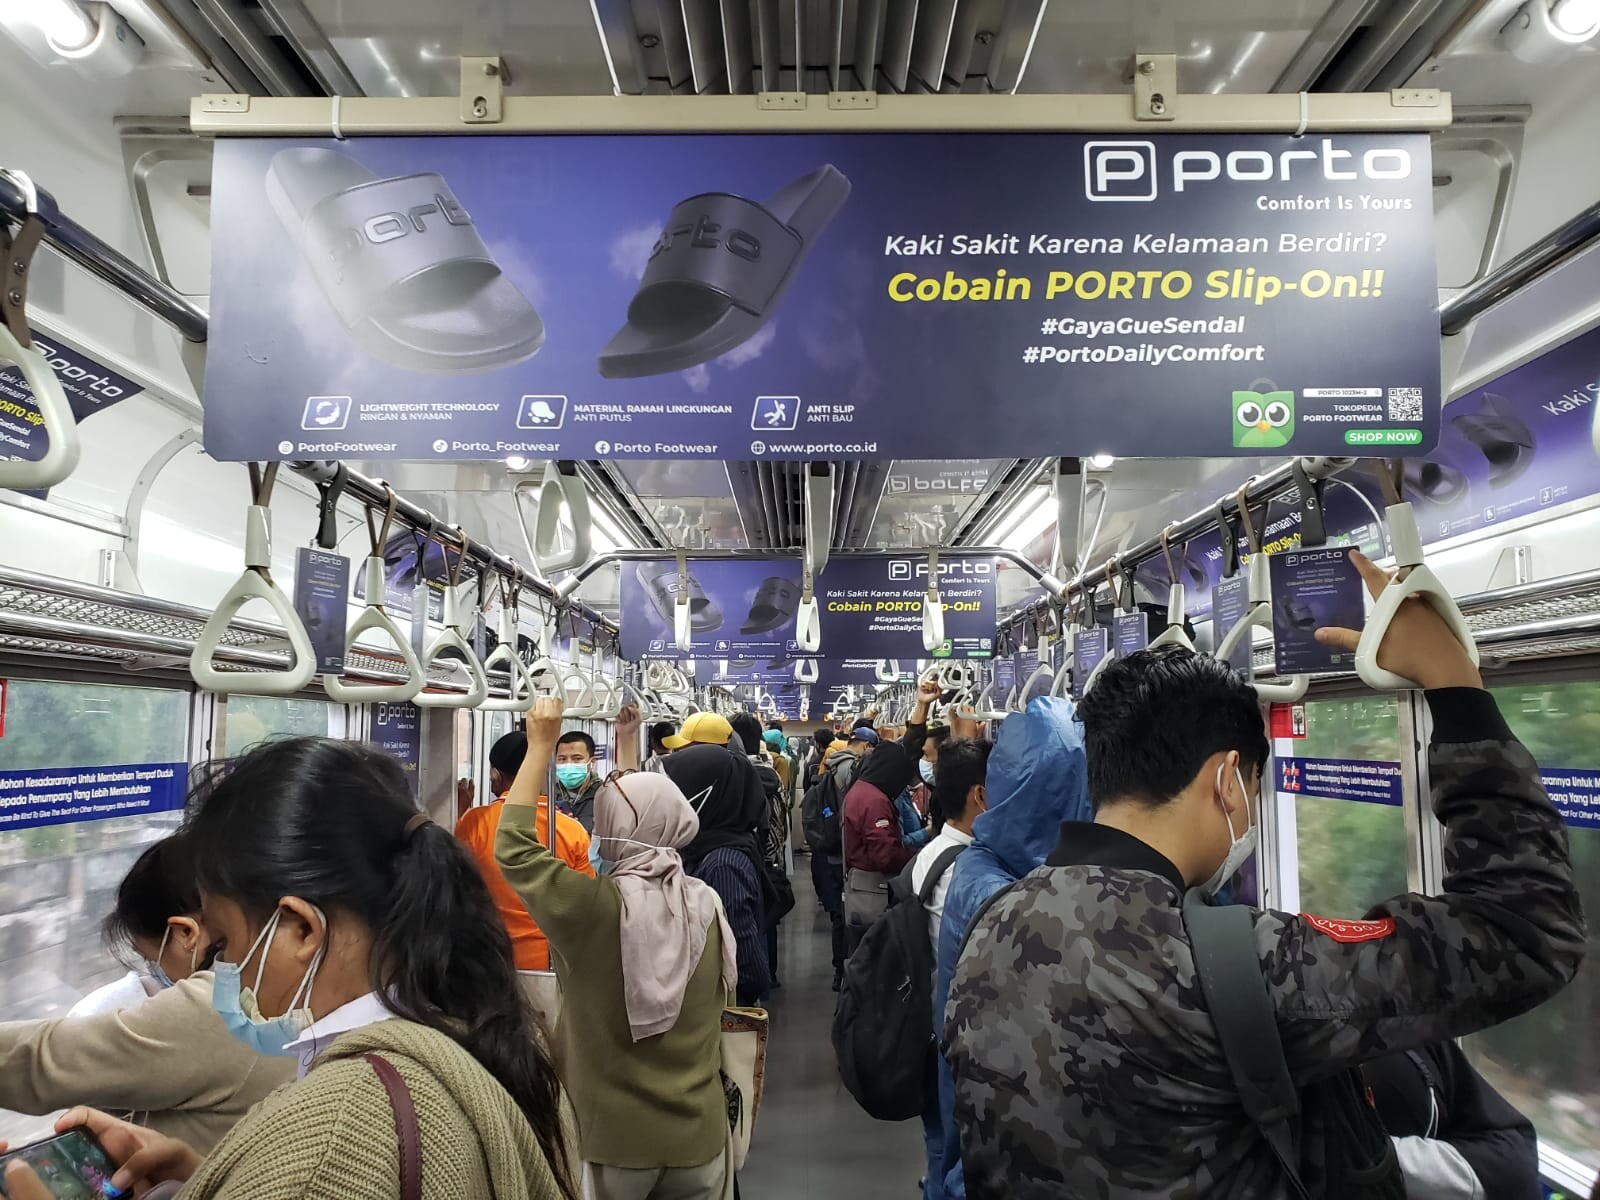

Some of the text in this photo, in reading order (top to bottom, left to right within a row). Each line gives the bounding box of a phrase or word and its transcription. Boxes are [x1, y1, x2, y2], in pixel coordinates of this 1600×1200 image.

[1172, 138, 1413, 192] porto
[1256, 195, 1413, 211] Comfort Is Yours
[884, 232, 1388, 257] Kaki Sakit Karena Kelamaan Berdiri?
[887, 267, 1384, 305] Cobain PORTO Slip-On!!
[1041, 316, 1245, 338] #GayaGueSendal
[1022, 343, 1265, 366] #PortoDailyComfort
[0, 399, 26, 418] ORTO
[359, 403, 500, 412] LIGHTWEIGHT TECHNOLOGY
[573, 404, 733, 413] MATERIAL RAMAH LINGKUNGAN
[807, 404, 855, 413] ANTI SLIP
[1333, 404, 1383, 412] TOKOPEDIA
[1541, 389, 1593, 416] Kaki
[359, 412, 453, 421] RINGAN & NYAMAN
[573, 413, 633, 422] ANTI PUTUS
[807, 413, 854, 422] ANTI BAU
[1303, 414, 1383, 422] PORTO FOOTWEAR
[1349, 432, 1418, 442] SHOP NOW
[298, 441, 398, 453] PortoFootwear
[452, 441, 561, 453] Porto_Footwear
[614, 442, 718, 453] Porto Footwear
[769, 441, 877, 455] www.porto.co.id
[1300, 551, 1343, 564] porto
[827, 590, 845, 598] Kaki
[847, 590, 869, 598] Sakit
[870, 590, 901, 598] Karena
[947, 589, 983, 598] Berdiri?
[827, 602, 872, 612] Cobain
[875, 602, 921, 612] PORTO
[1571, 776, 1593, 788] Untuk
[0, 795, 27, 808] epada
[73, 789, 90, 801] Yang
[1568, 791, 1589, 806] Yang
